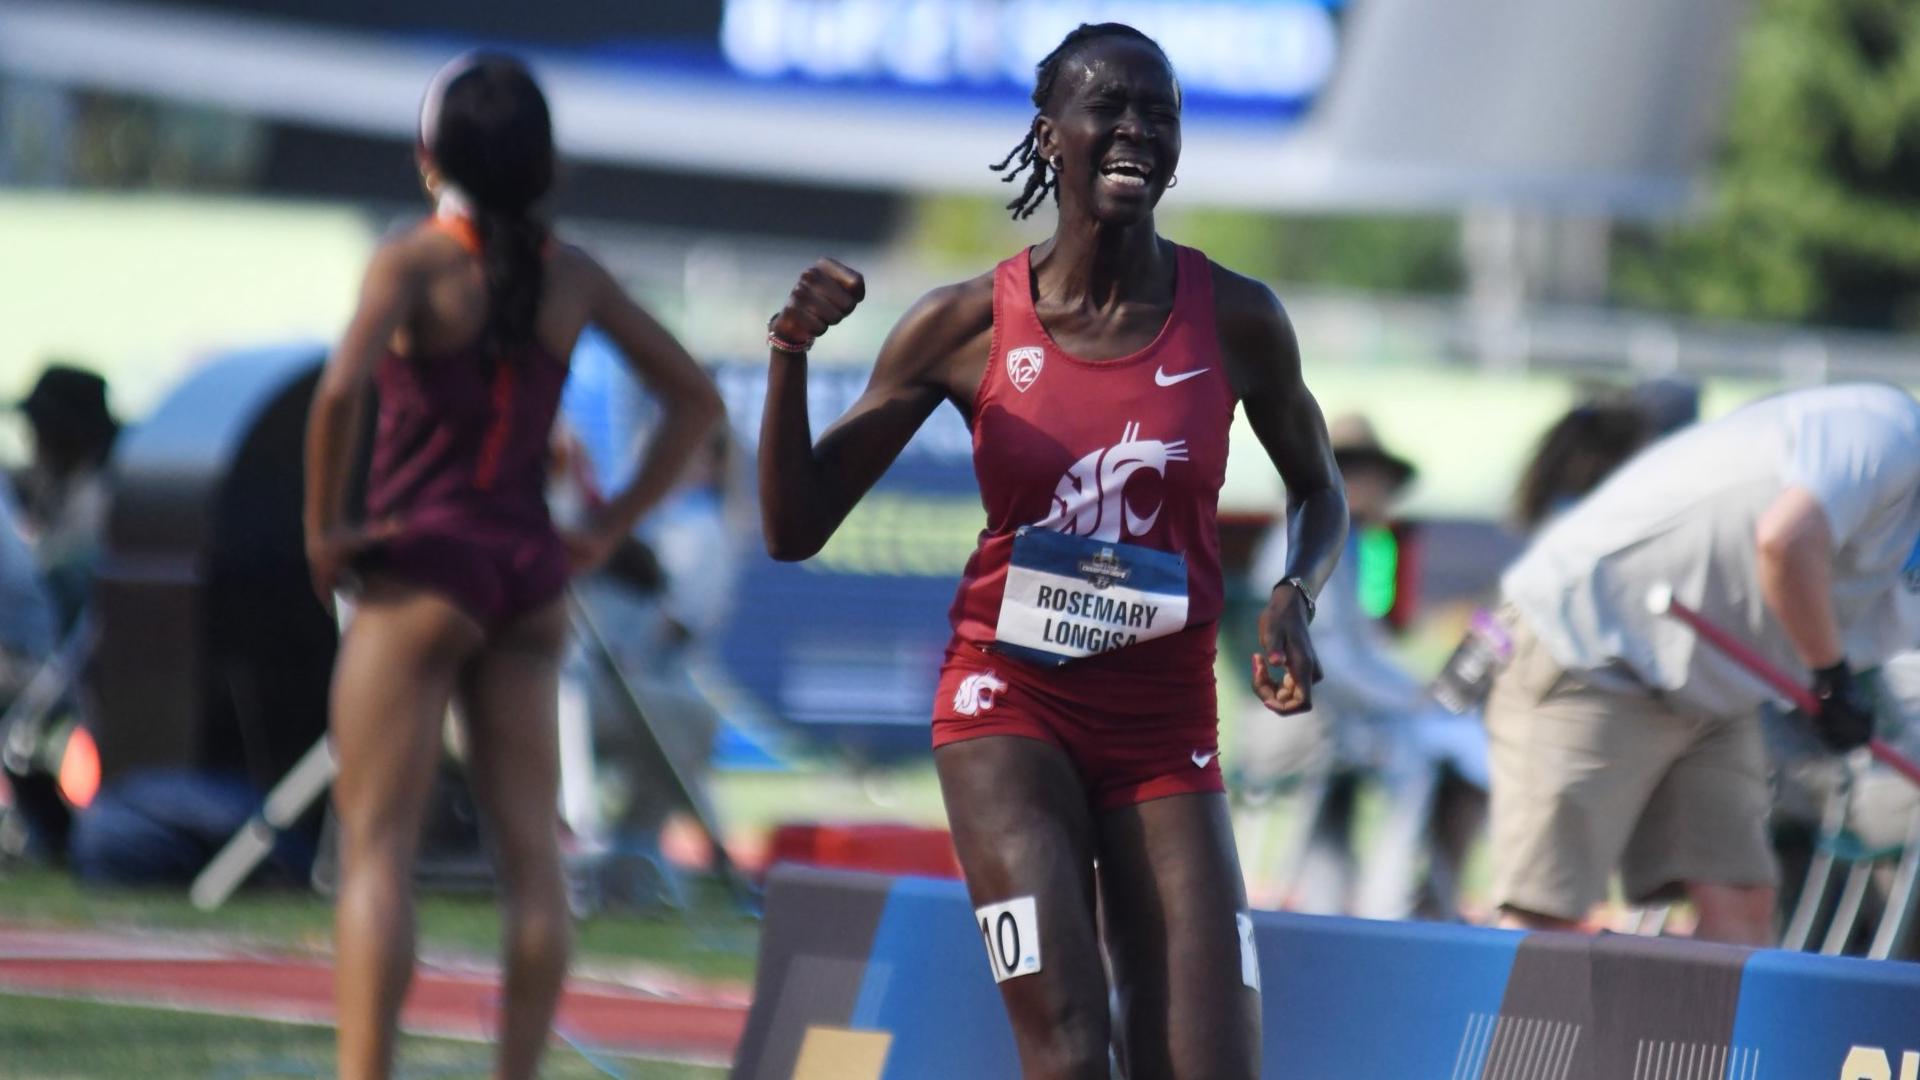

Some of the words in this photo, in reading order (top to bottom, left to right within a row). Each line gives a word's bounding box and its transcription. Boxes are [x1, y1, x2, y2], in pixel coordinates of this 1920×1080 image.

[1008, 348, 1042, 374] PAC
[1015, 366, 1033, 383] 12
[1037, 585, 1158, 629] ROSEMARY
[982, 911, 1020, 977] 10
